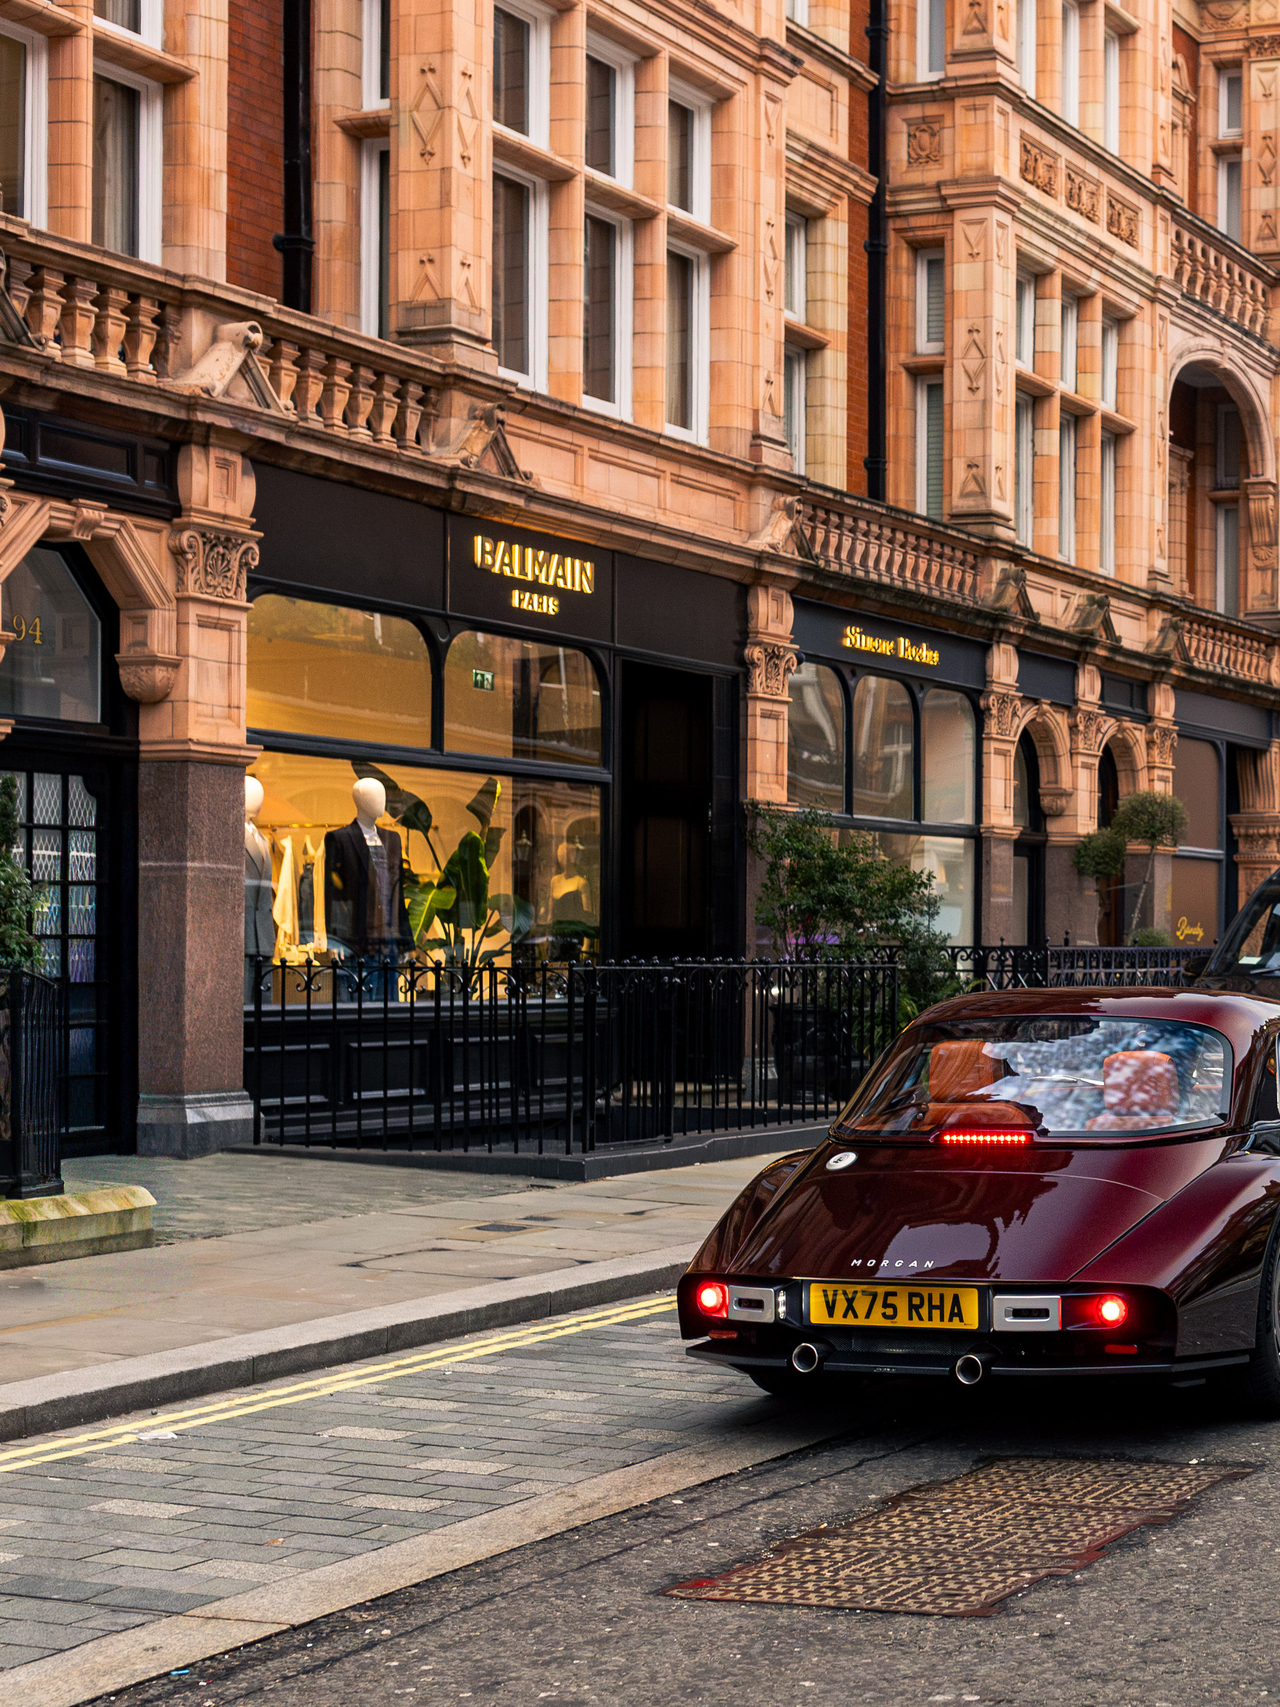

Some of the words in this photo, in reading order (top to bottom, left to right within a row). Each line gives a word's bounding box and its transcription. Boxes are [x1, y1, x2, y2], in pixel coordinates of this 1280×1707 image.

[474, 535, 594, 594] BALMAIN
[511, 589, 559, 615] PARIS
[13, 615, 43, 644] 94
[842, 625, 895, 656] Simone
[850, 1259, 935, 1268] MORGAN
[822, 1289, 898, 1320] VX75
[907, 1291, 964, 1323] RHA
